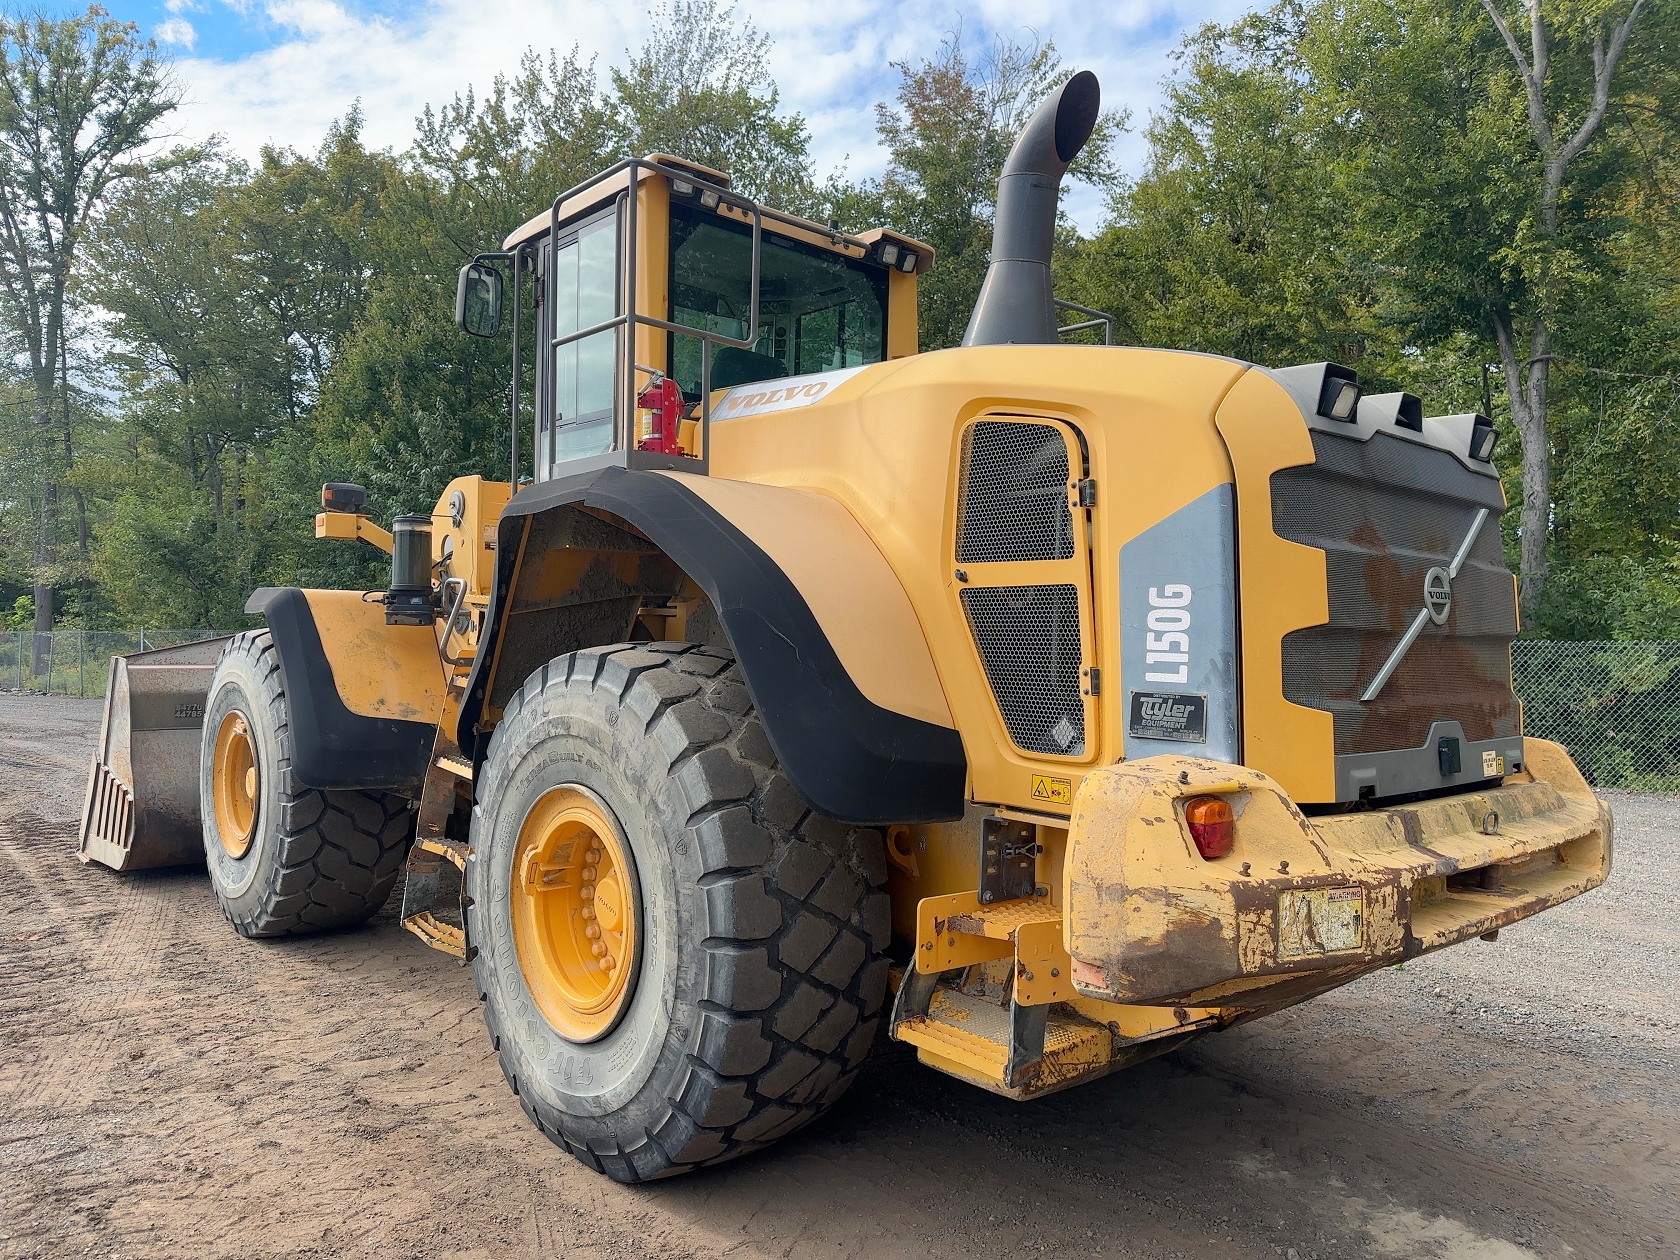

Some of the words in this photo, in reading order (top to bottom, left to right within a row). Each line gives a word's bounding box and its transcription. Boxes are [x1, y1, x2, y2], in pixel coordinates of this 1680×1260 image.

[728, 381, 828, 411] VOLVO
[1428, 591, 1450, 600] VOLV
[1145, 583, 1192, 684] L150G
[1139, 697, 1195, 721] Tyler
[1142, 720, 1187, 729] EQUIPMENT
